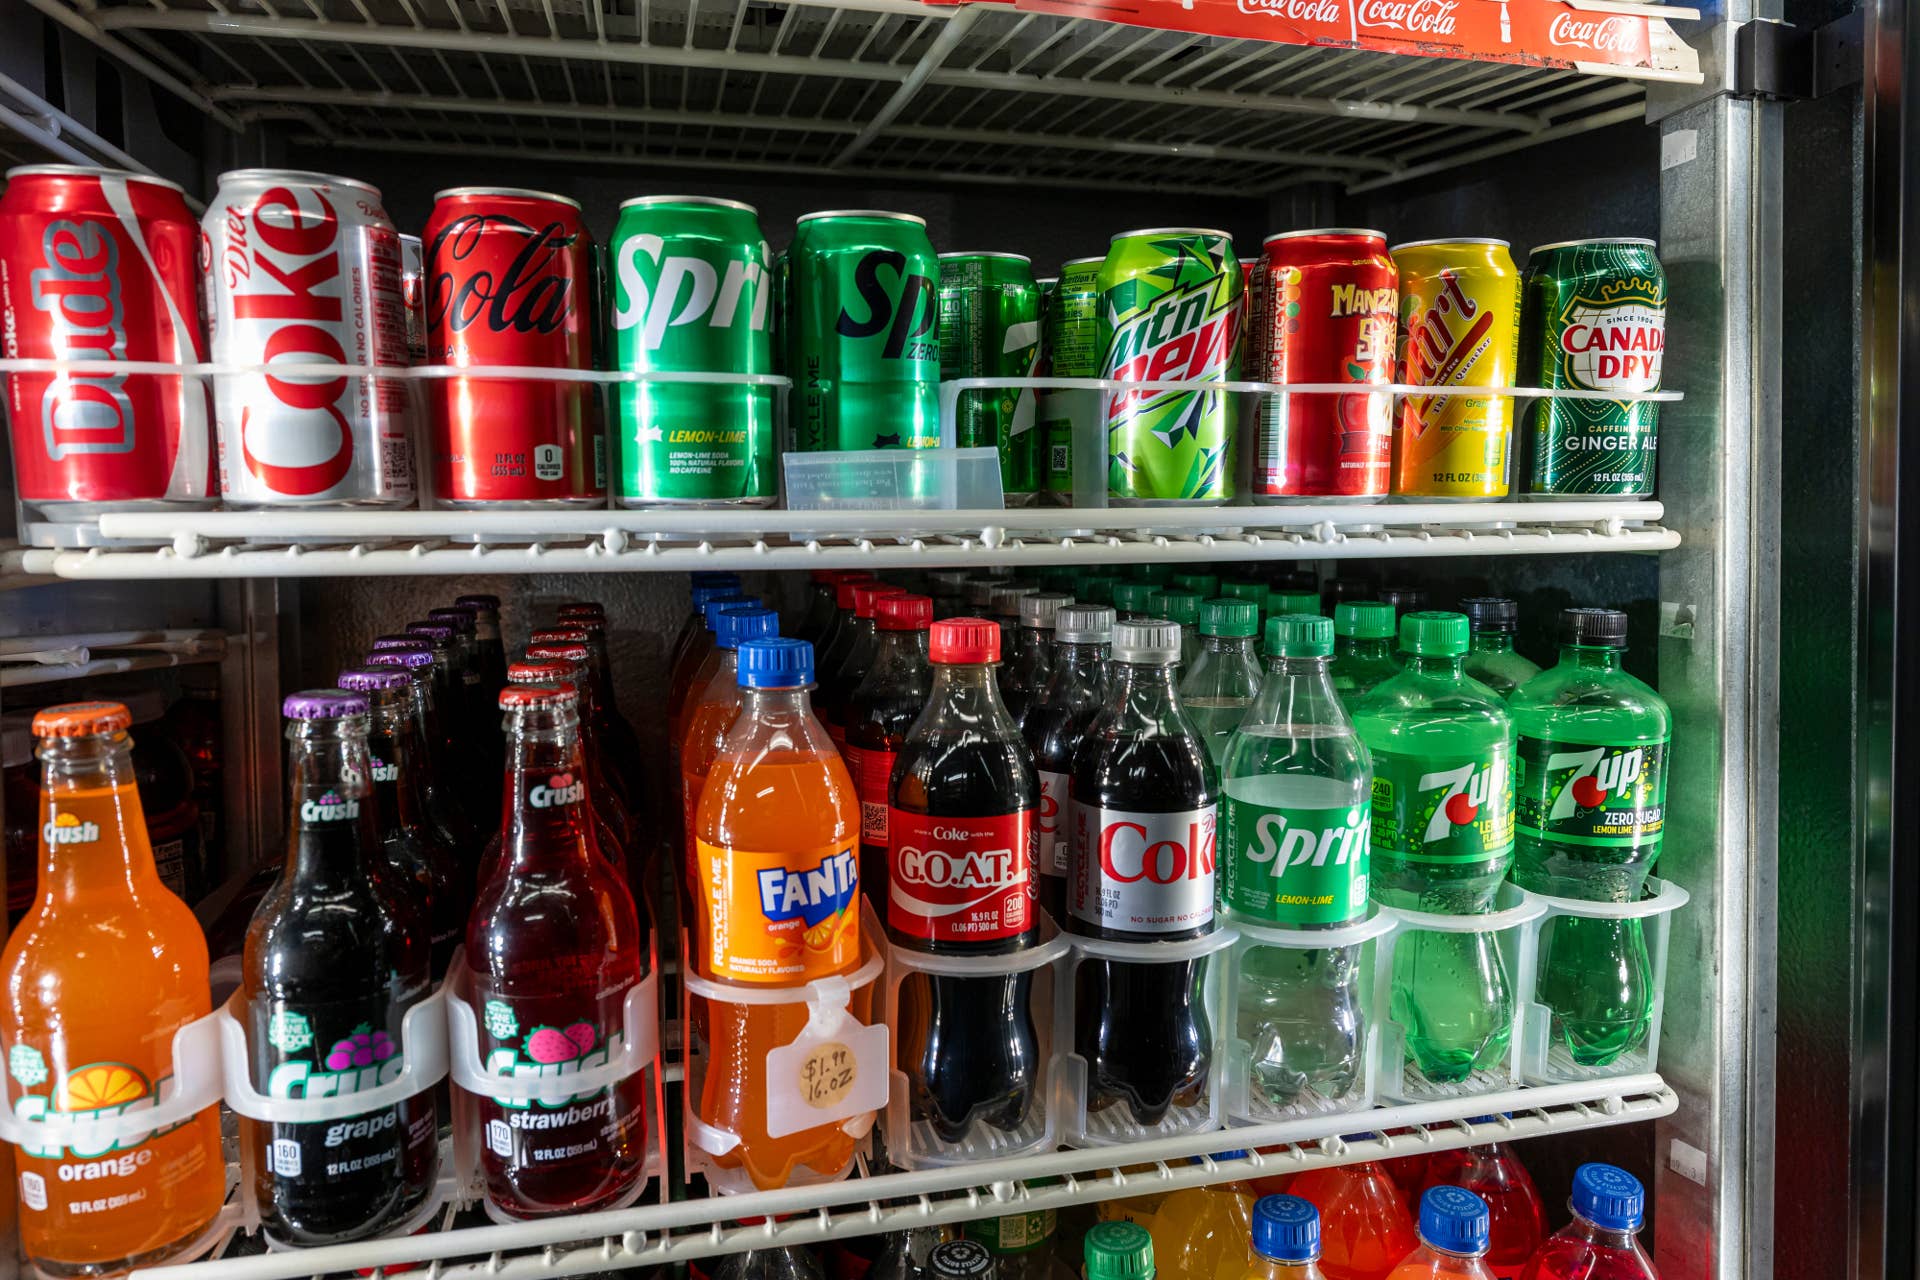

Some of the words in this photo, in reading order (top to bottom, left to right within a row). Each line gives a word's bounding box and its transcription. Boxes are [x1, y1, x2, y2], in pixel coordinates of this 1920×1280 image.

[1549, 12, 1640, 53] Coca-Cola
[222, 205, 250, 289] Diet
[427, 213, 580, 335] Cola
[351, 267, 365, 329] CALORIES
[835, 251, 941, 360] Sp
[1274, 269, 1287, 351] RECYCLE
[1606, 315, 1634, 324] SINCE
[4, 309, 18, 359] oke
[38, 223, 132, 458] Dude
[232, 186, 354, 496] Coke
[355, 332, 366, 350] NO
[906, 342, 939, 362] ZERO
[1454, 336, 1493, 381] Quencher
[808, 355, 820, 389] ME
[1597, 354, 1655, 380] DRY
[669, 430, 747, 443] LEMON-LIME
[1564, 435, 1639, 451] GINGER
[1641, 436, 1658, 450] ALE
[544, 448, 553, 463] 0
[1432, 472, 1444, 483] 12
[1445, 472, 1456, 483] FL
[1457, 472, 1471, 483] OZ
[530, 781, 586, 809] Crush
[1373, 781, 1390, 797] 240
[1547, 747, 1643, 821] 7up
[300, 801, 360, 822] Crush
[1228, 802, 1236, 827] ME
[1605, 813, 1634, 826] ZERO
[1636, 808, 1661, 825] SUGAR
[43, 822, 100, 844] Crush
[932, 826, 969, 841] Coke
[1593, 825, 1617, 834] LEMON
[1617, 825, 1633, 834] LIME
[711, 856, 722, 885] ME
[899, 848, 1014, 886] G.O.A.T.
[1226, 831, 1236, 900] RECYCLE
[759, 851, 858, 912] FANTA
[1006, 896, 1023, 912] 200
[1275, 894, 1335, 905] LEMON-LIME
[711, 888, 724, 967] RECYCLE
[768, 920, 800, 932] orange
[1131, 916, 1144, 924] NO
[1146, 916, 1175, 924] SUGAR
[758, 958, 778, 966] SODA
[802, 1050, 847, 1083] $1.99
[510, 1098, 616, 1130] strawberry
[324, 1111, 397, 1147] grape
[493, 1122, 509, 1140] 170
[277, 1143, 297, 1159] 160
[58, 1150, 153, 1182] orange
